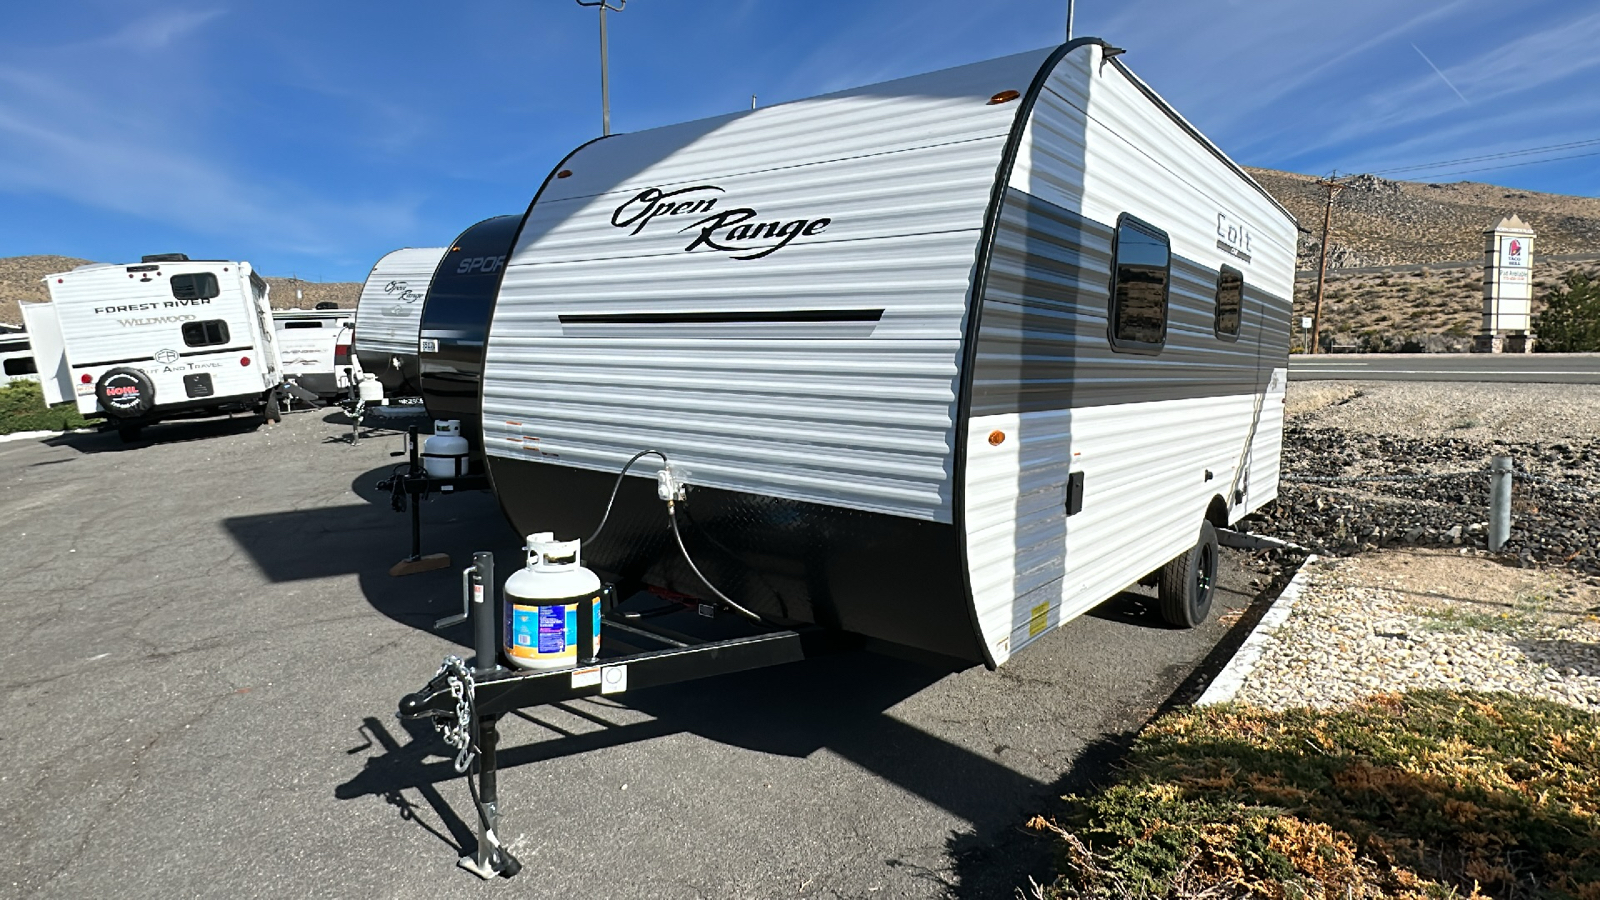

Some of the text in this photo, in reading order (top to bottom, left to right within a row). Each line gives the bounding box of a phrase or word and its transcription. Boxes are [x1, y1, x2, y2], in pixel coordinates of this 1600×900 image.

[611, 185, 726, 236] Open
[677, 208, 832, 260] Range
[1216, 212, 1252, 253] Colt
[384, 280, 409, 295] Open
[398, 289, 424, 303] Range
[94, 298, 211, 314] FOREST RIVER
[117, 314, 197, 327] WILDWOOD
